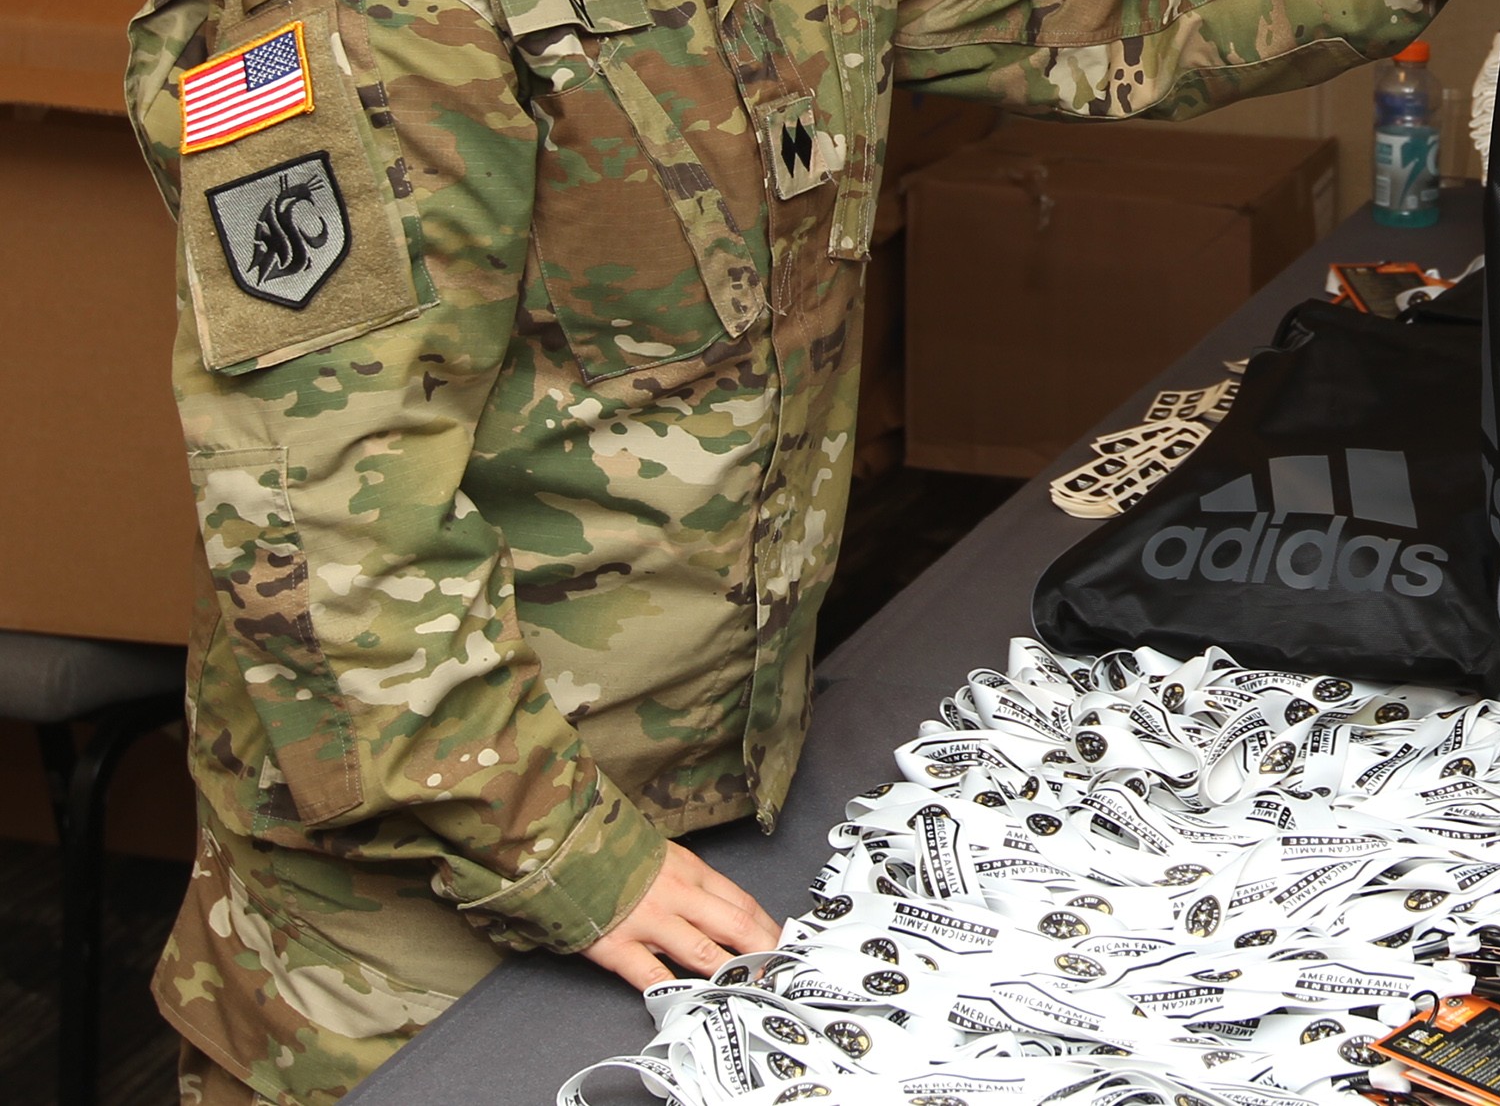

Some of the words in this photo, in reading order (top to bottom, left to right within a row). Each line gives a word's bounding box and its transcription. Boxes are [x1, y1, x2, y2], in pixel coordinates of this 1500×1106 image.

[1141, 511, 1449, 597] adidas
[892, 914, 930, 932] FAMILY
[901, 905, 991, 936] INSURANCE
[930, 925, 995, 947] AMERICAN
[1299, 972, 1363, 986] AMERICAN
[1367, 978, 1412, 991] FAMILY
[1303, 982, 1401, 998] INSURANCE
